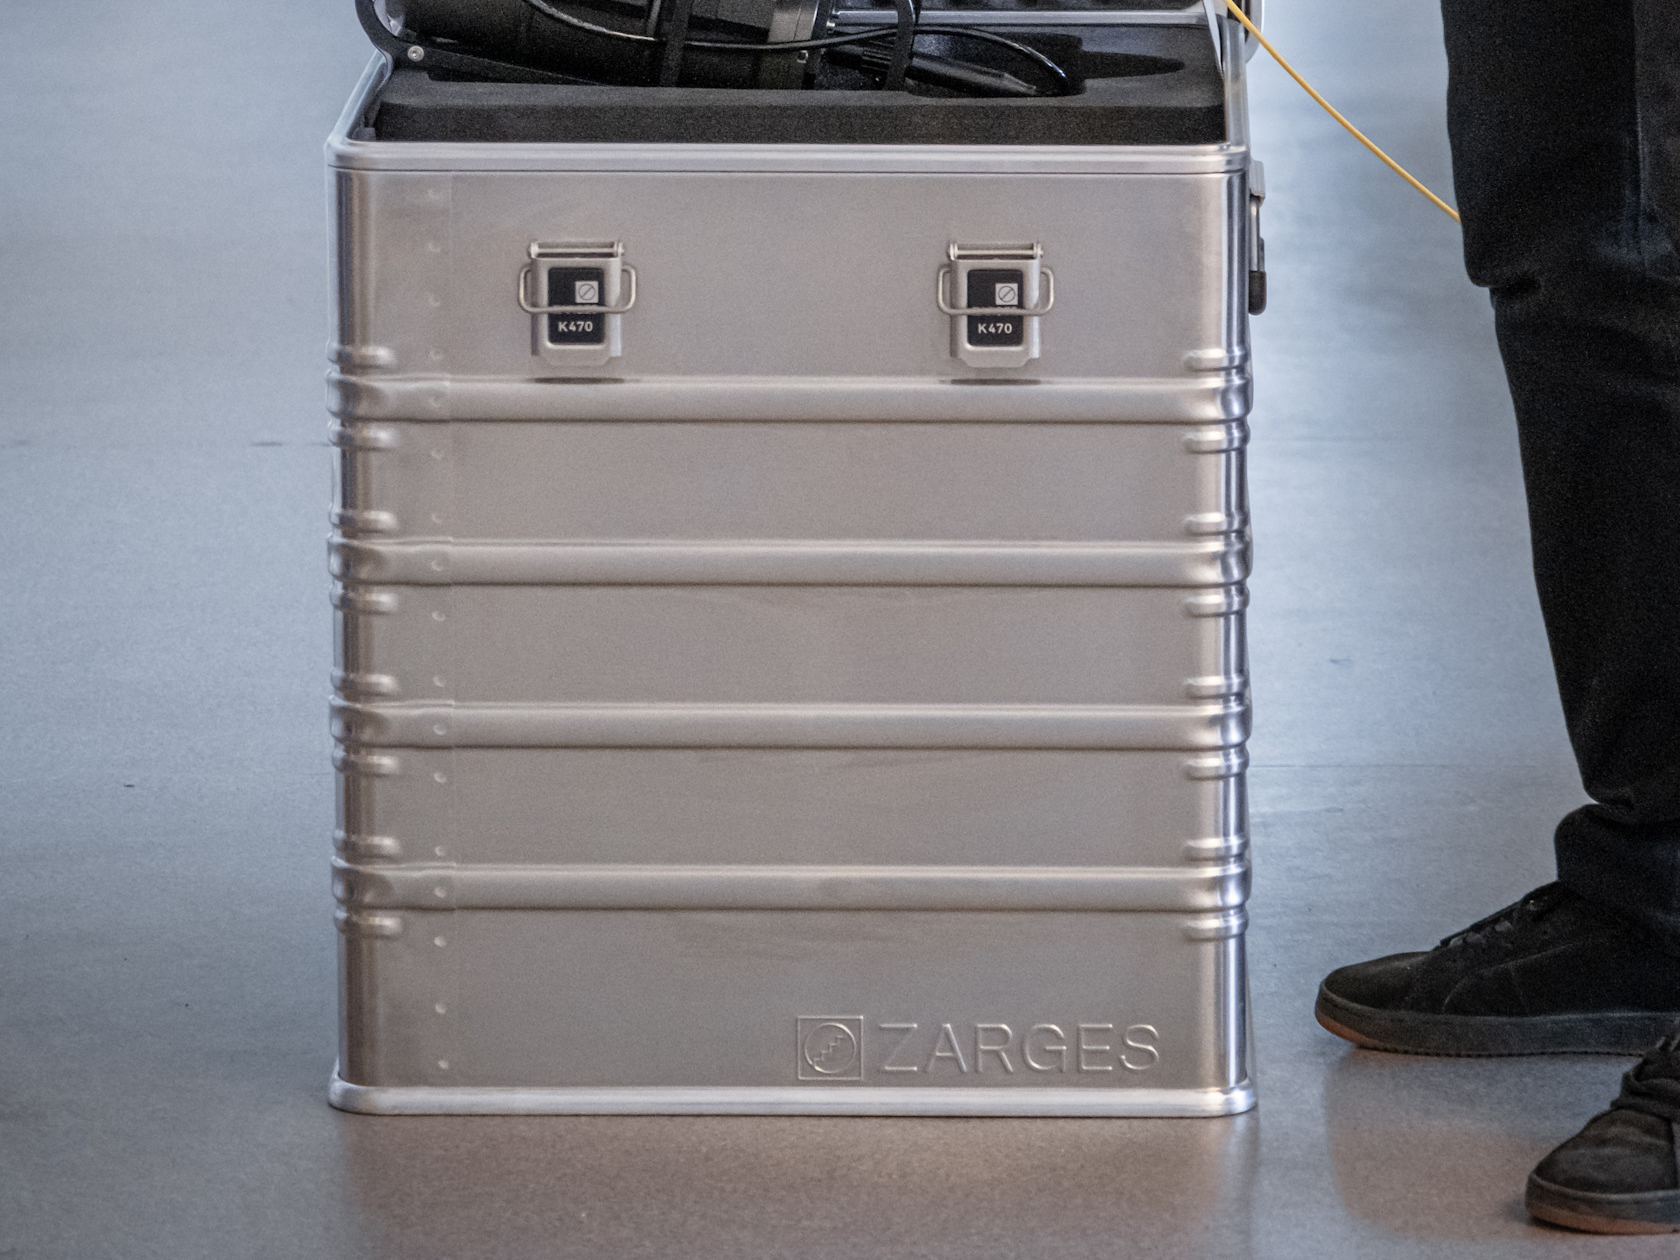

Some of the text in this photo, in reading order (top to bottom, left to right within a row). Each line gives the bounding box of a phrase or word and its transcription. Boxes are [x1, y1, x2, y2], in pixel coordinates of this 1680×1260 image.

[558, 321, 593, 332] K470
[978, 323, 1012, 334] K470
[878, 1023, 1160, 1073] ZARGES
